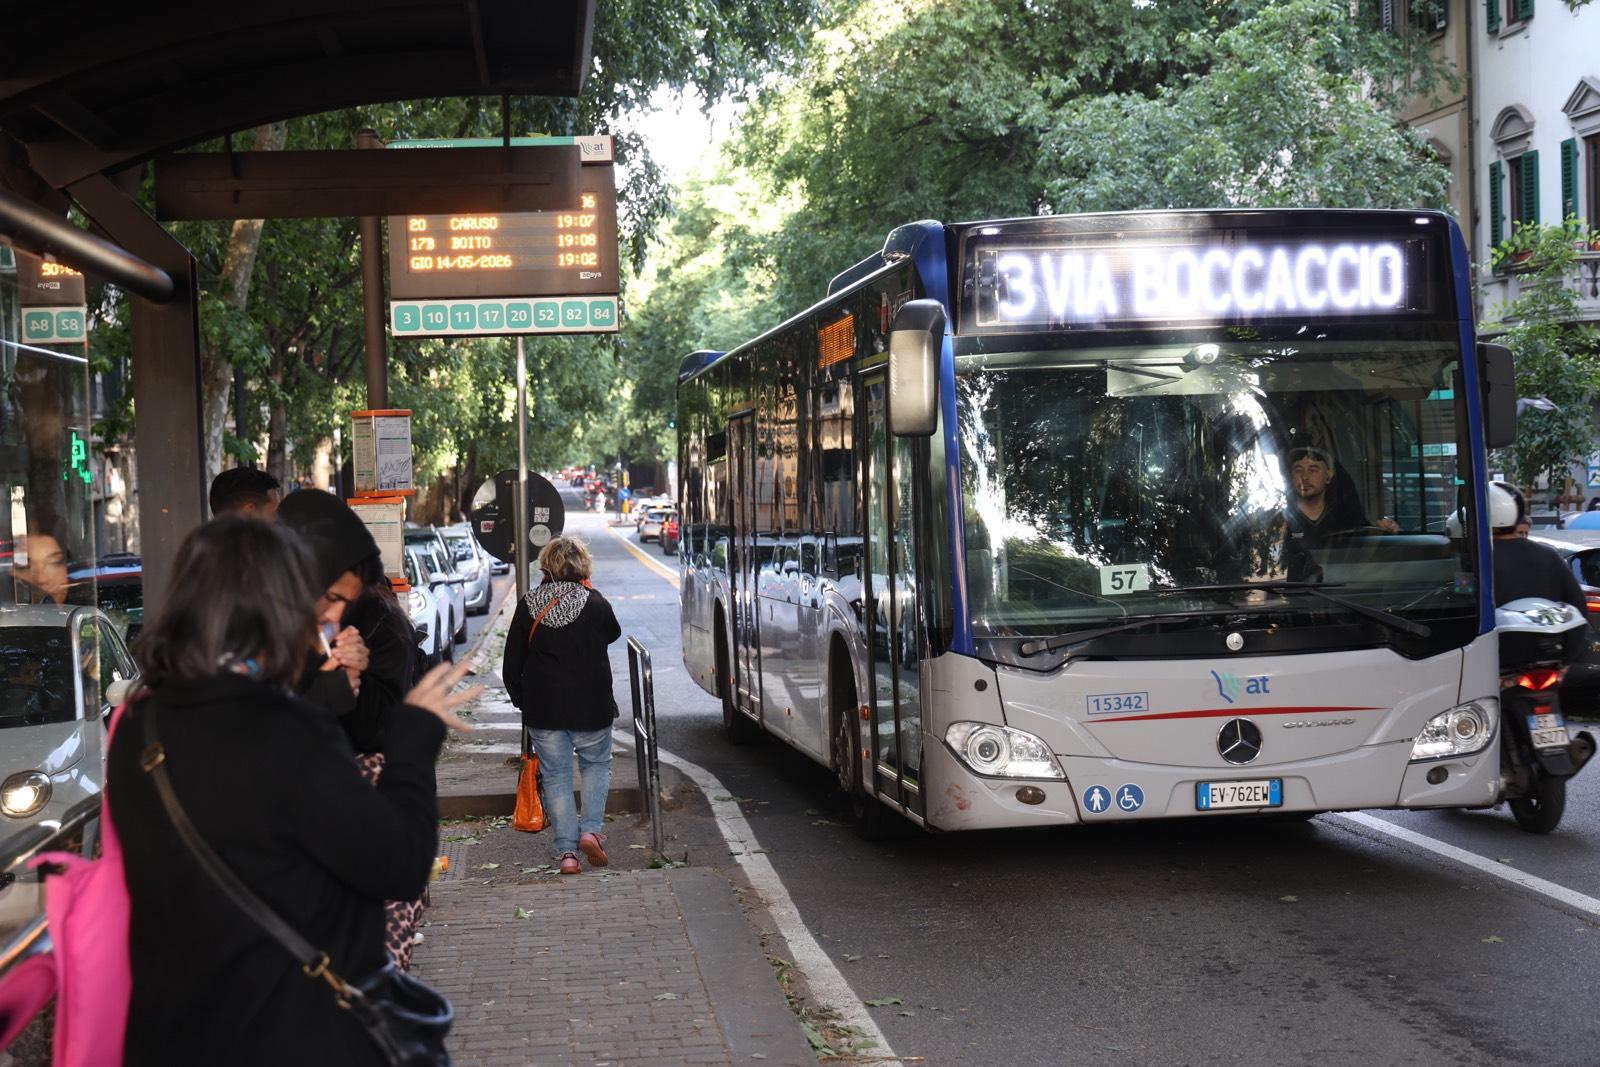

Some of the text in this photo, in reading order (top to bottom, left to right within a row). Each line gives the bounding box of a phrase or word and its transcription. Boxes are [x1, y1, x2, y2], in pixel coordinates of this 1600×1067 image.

[594, 143, 604, 151] at
[409, 214, 596, 231] 20 CARUSO 19:07
[411, 233, 597, 250] 17B BOITO 19:08
[411, 252, 598, 270] GIO 14/05/2026 19:02
[998, 244, 1404, 317] 3 VIA BOCCACCIO
[403, 308, 610, 325] 3 10 11 17 20 52 82 84
[1111, 570, 1137, 590] 57
[1246, 675, 1270, 694] at
[1092, 695, 1143, 712] 15342
